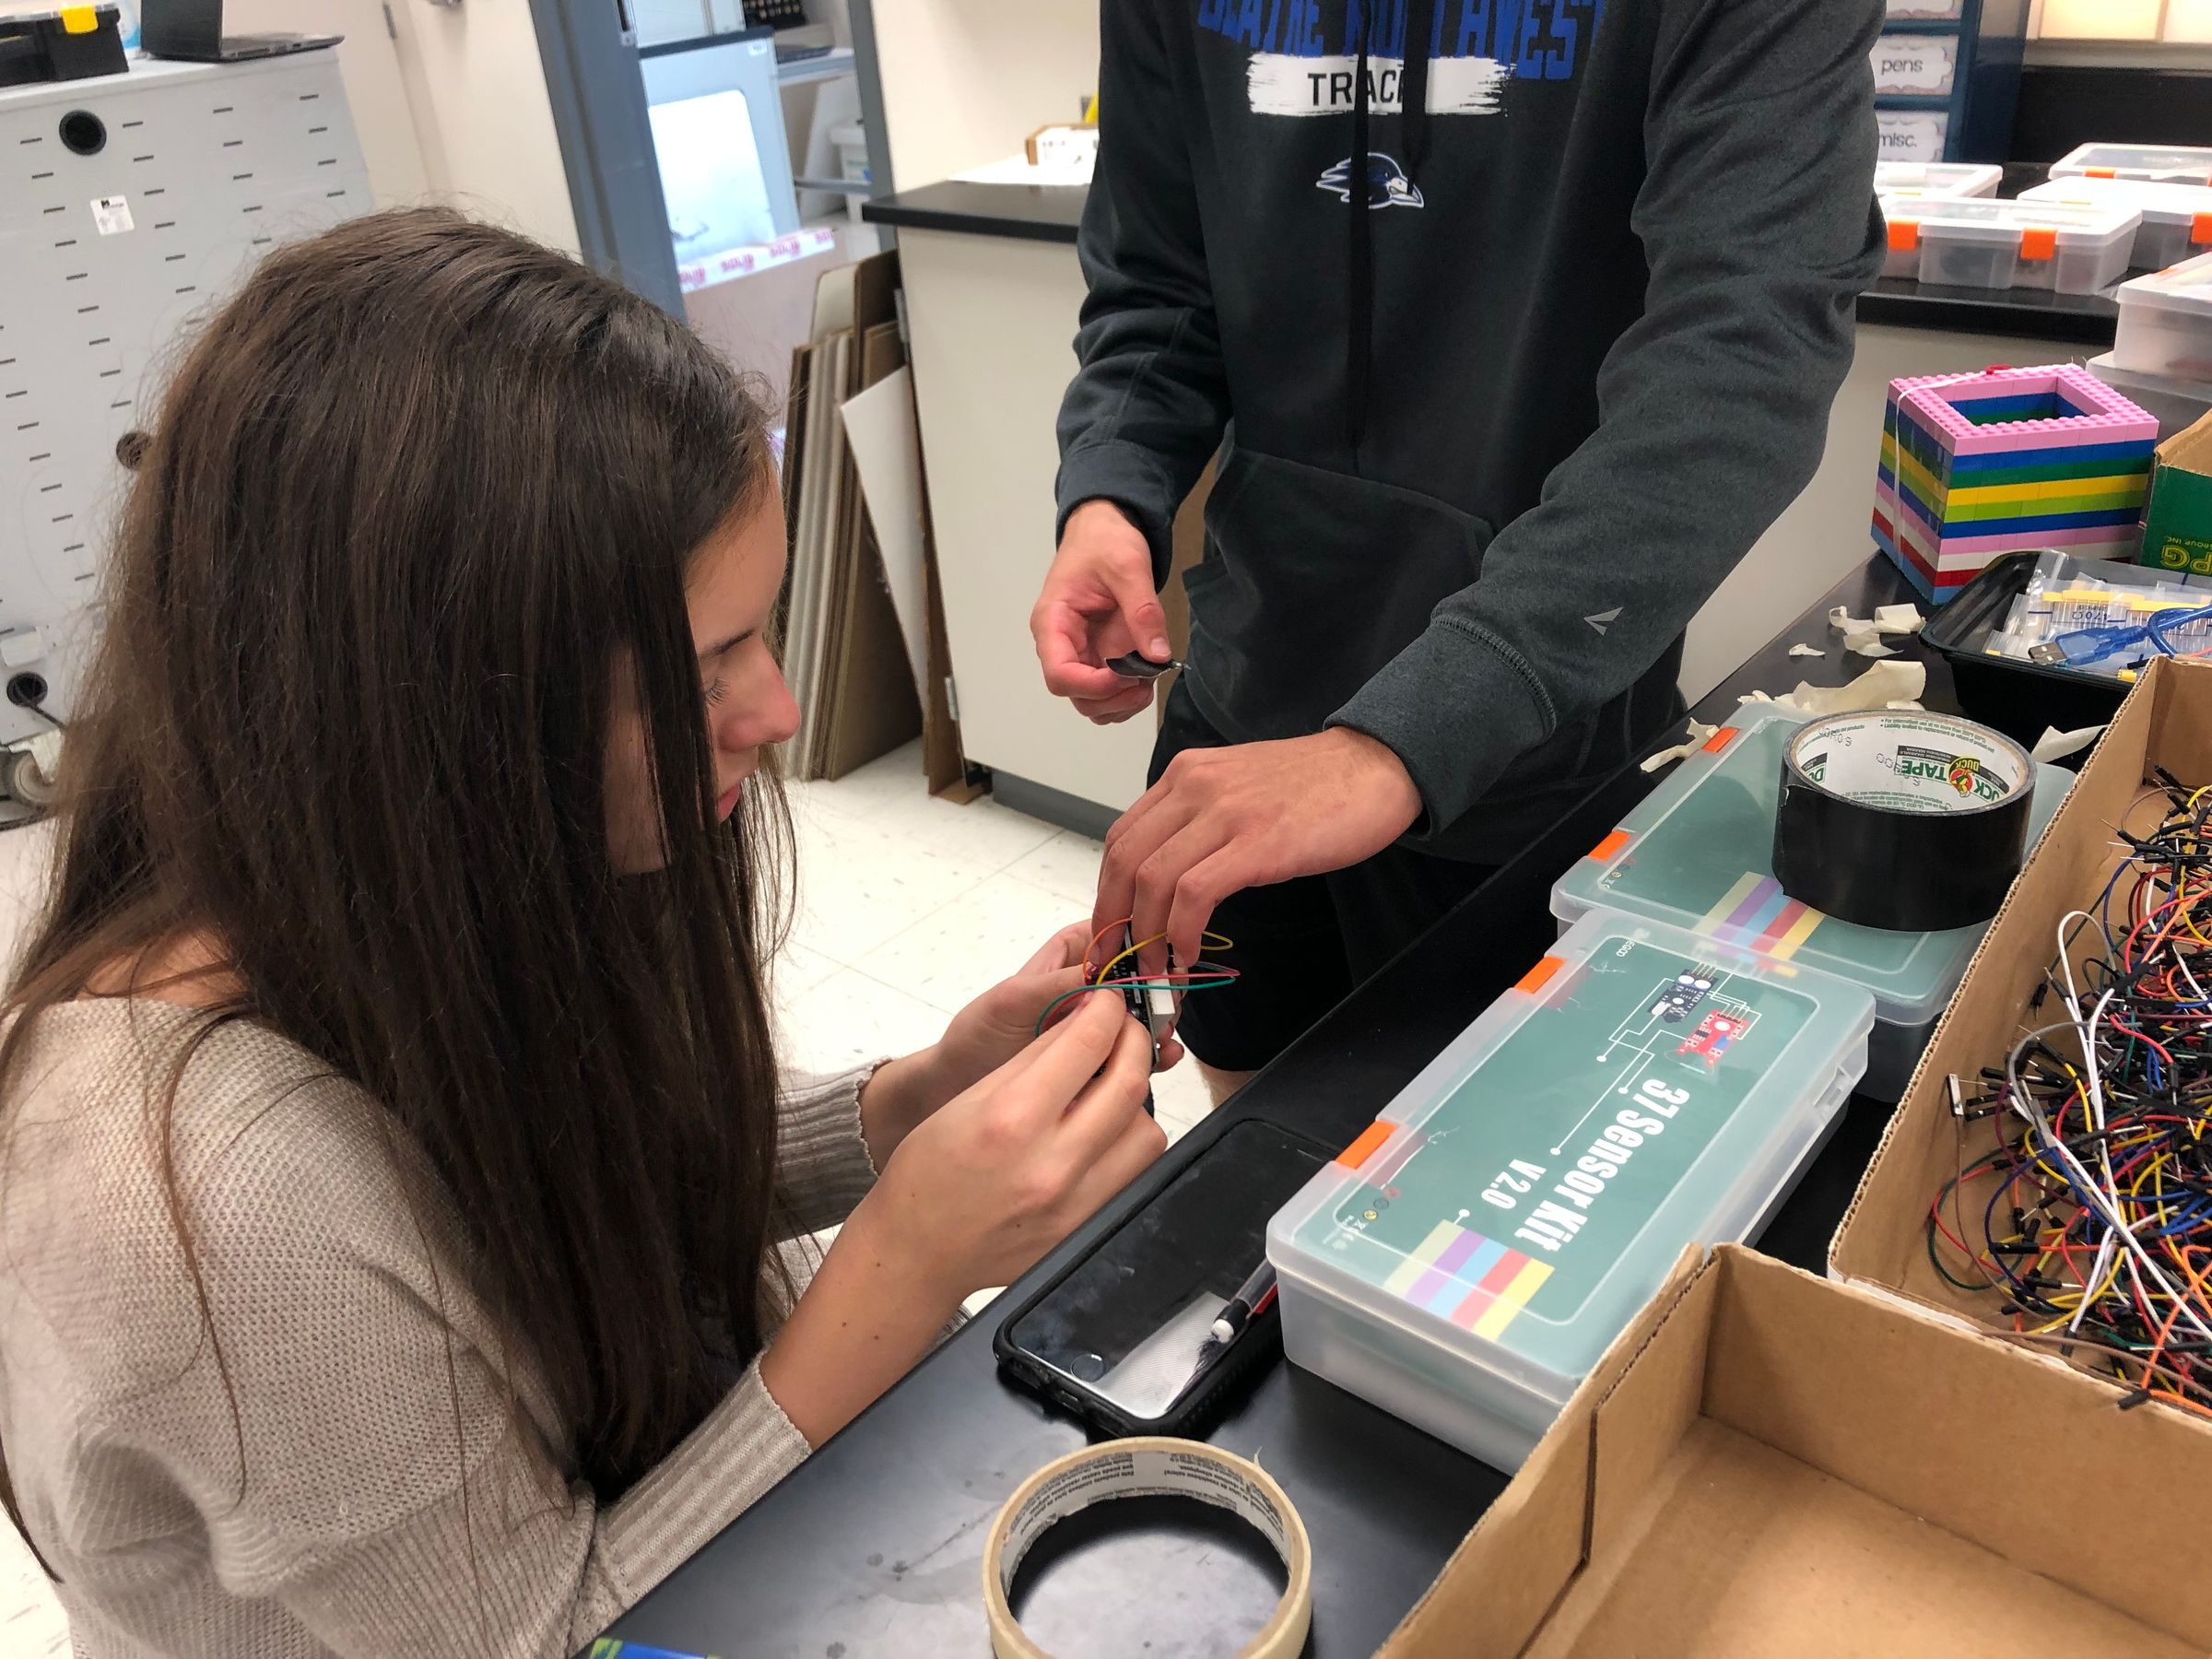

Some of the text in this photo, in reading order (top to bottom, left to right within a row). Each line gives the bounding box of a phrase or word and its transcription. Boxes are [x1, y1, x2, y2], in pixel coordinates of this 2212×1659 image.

[1881, 57, 1924, 75] pens
[1880, 132, 1918, 148] misc.
[2167, 536, 2183, 545] INC
[1901, 759, 1947, 782] TAPE
[1955, 759, 1980, 773] DUCK
[1973, 778, 2000, 801] UCK
[1513, 1077, 1690, 1253] 37 Sensor Kit
